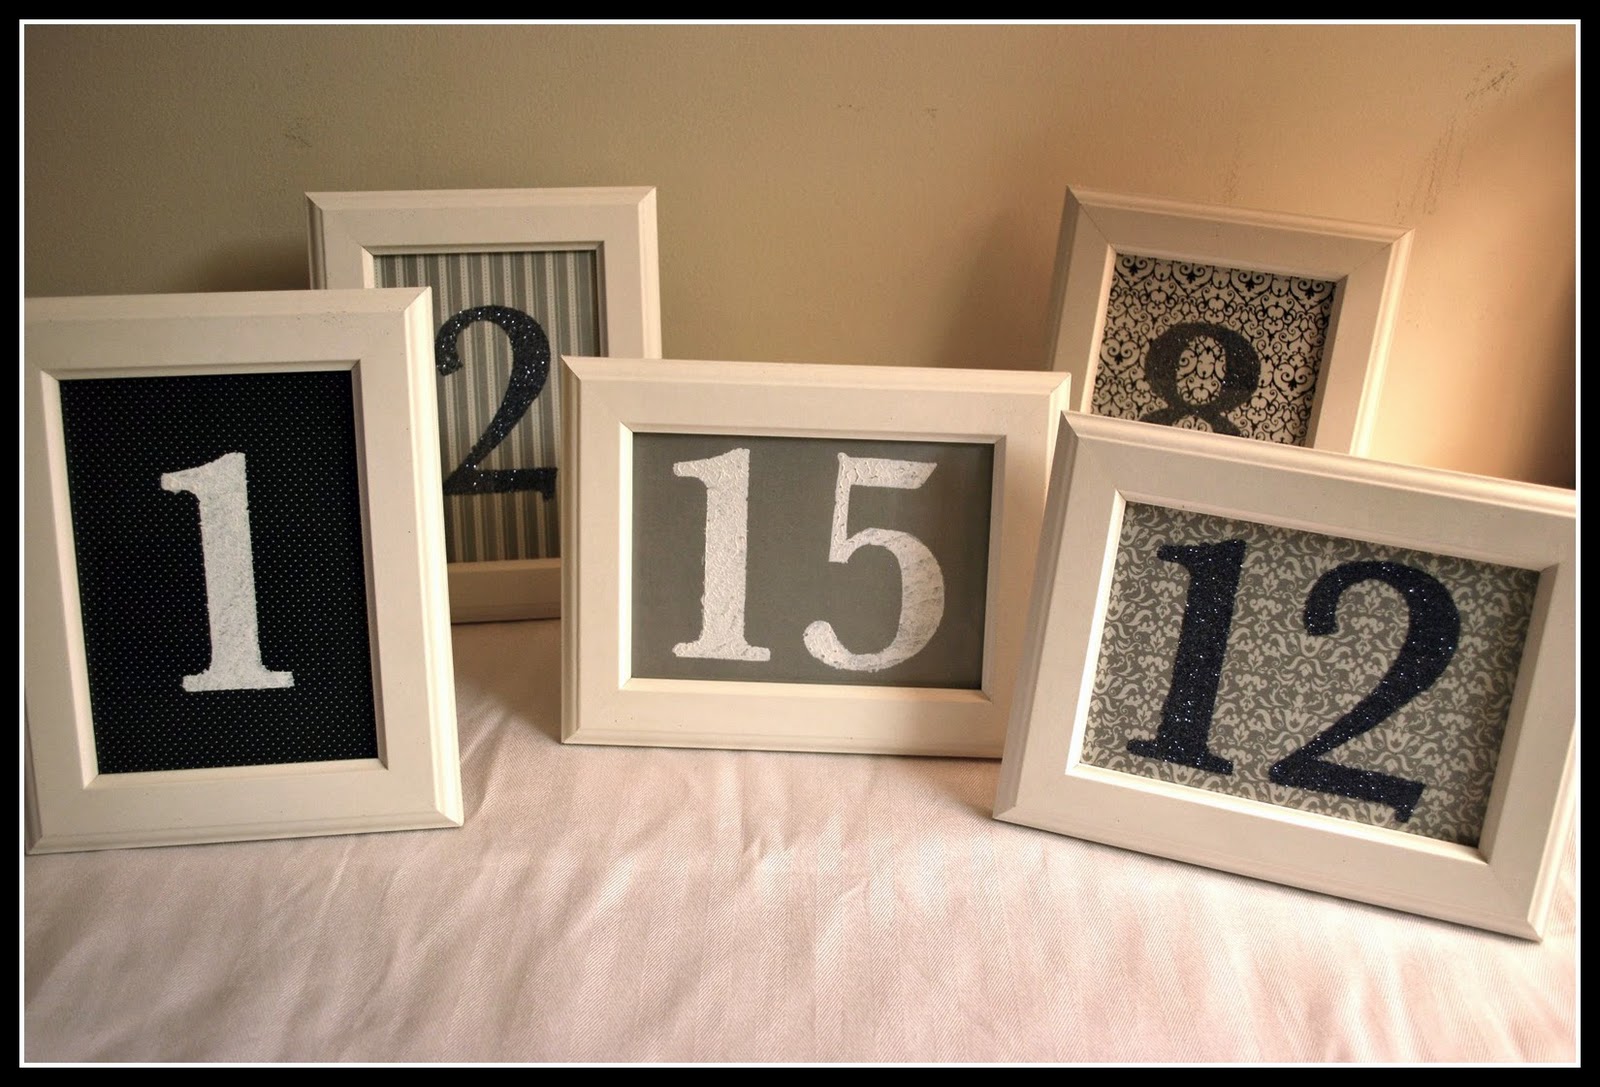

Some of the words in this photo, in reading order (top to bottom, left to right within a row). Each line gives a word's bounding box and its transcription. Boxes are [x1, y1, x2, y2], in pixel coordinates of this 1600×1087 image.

[435, 304, 557, 500] 2
[160, 452, 294, 692] 1
[672, 447, 945, 672] 15
[1127, 539, 1461, 822] 12
